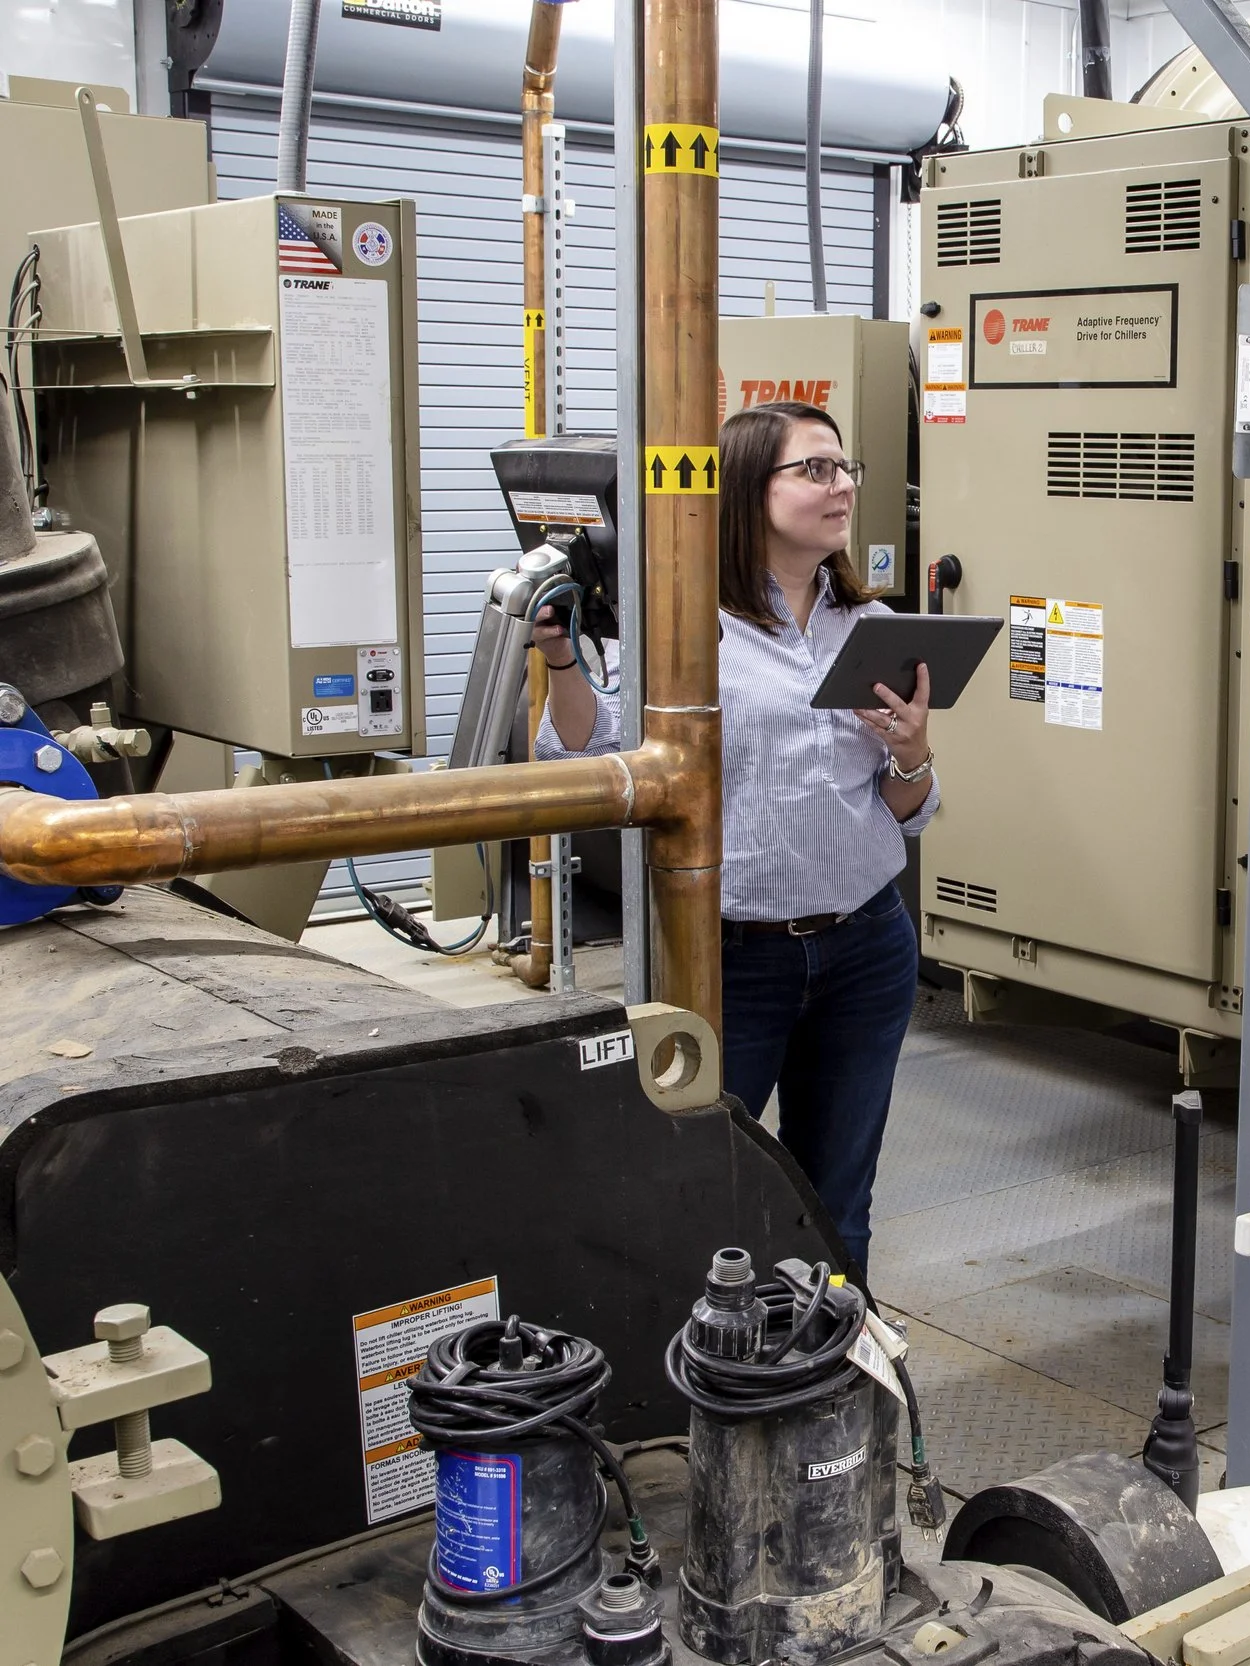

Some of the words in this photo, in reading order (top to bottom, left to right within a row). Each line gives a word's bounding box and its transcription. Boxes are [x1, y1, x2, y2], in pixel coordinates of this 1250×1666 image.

[344, 5, 401, 19] COMMERCIAL
[405, 14, 434, 24] DOORS
[312, 210, 338, 219] MADE
[313, 232, 338, 241] U.S.A.
[293, 279, 331, 290] TRANE
[1012, 317, 1050, 332] TRANE
[1077, 317, 1113, 328] Adaptive
[1115, 315, 1159, 327] Frequency
[936, 330, 962, 340] WARNING
[1077, 331, 1098, 341] Drive
[1100, 330, 1112, 340] for
[1114, 330, 1147, 340] Chillers
[1011, 342, 1037, 353] CHILLER
[1037, 343, 1044, 352] 2
[740, 380, 832, 411] TRANE
[310, 712, 318, 721] UL
[582, 1035, 630, 1065] LIFT
[409, 1294, 452, 1312] WARNING
[391, 1312, 431, 1329] IMPROPER
[432, 1303, 463, 1317] LIFTING!
[386, 1330, 403, 1339] chiller
[404, 1325, 425, 1336] utilizing
[425, 1317, 448, 1329] waterbox
[449, 1313, 464, 1323] lifting
[360, 1342, 385, 1353] Waterbox
[386, 1338, 402, 1347] lifting
[432, 1325, 445, 1333] used
[445, 1321, 456, 1331] only
[465, 1312, 489, 1323] removing
[361, 1350, 385, 1360] waterbox
[361, 1359, 380, 1367] Failure
[387, 1352, 403, 1360] follow
[414, 1344, 429, 1352] above
[362, 1366, 382, 1374] serious
[384, 1391, 406, 1400] soulever
[373, 1404, 390, 1412] levage
[368, 1433, 379, 1441] peut
[368, 1436, 393, 1447] blessures
[370, 1456, 401, 1471] FORMAS
[379, 1468, 398, 1477] levante
[405, 1458, 428, 1469] enfriador
[372, 1482, 392, 1492] colector
[401, 1475, 414, 1483] agua
[380, 1473, 401, 1483] colector
[378, 1487, 399, 1497] colector
[381, 1494, 400, 1504] cumplir
[394, 1496, 415, 1506] lesiones
